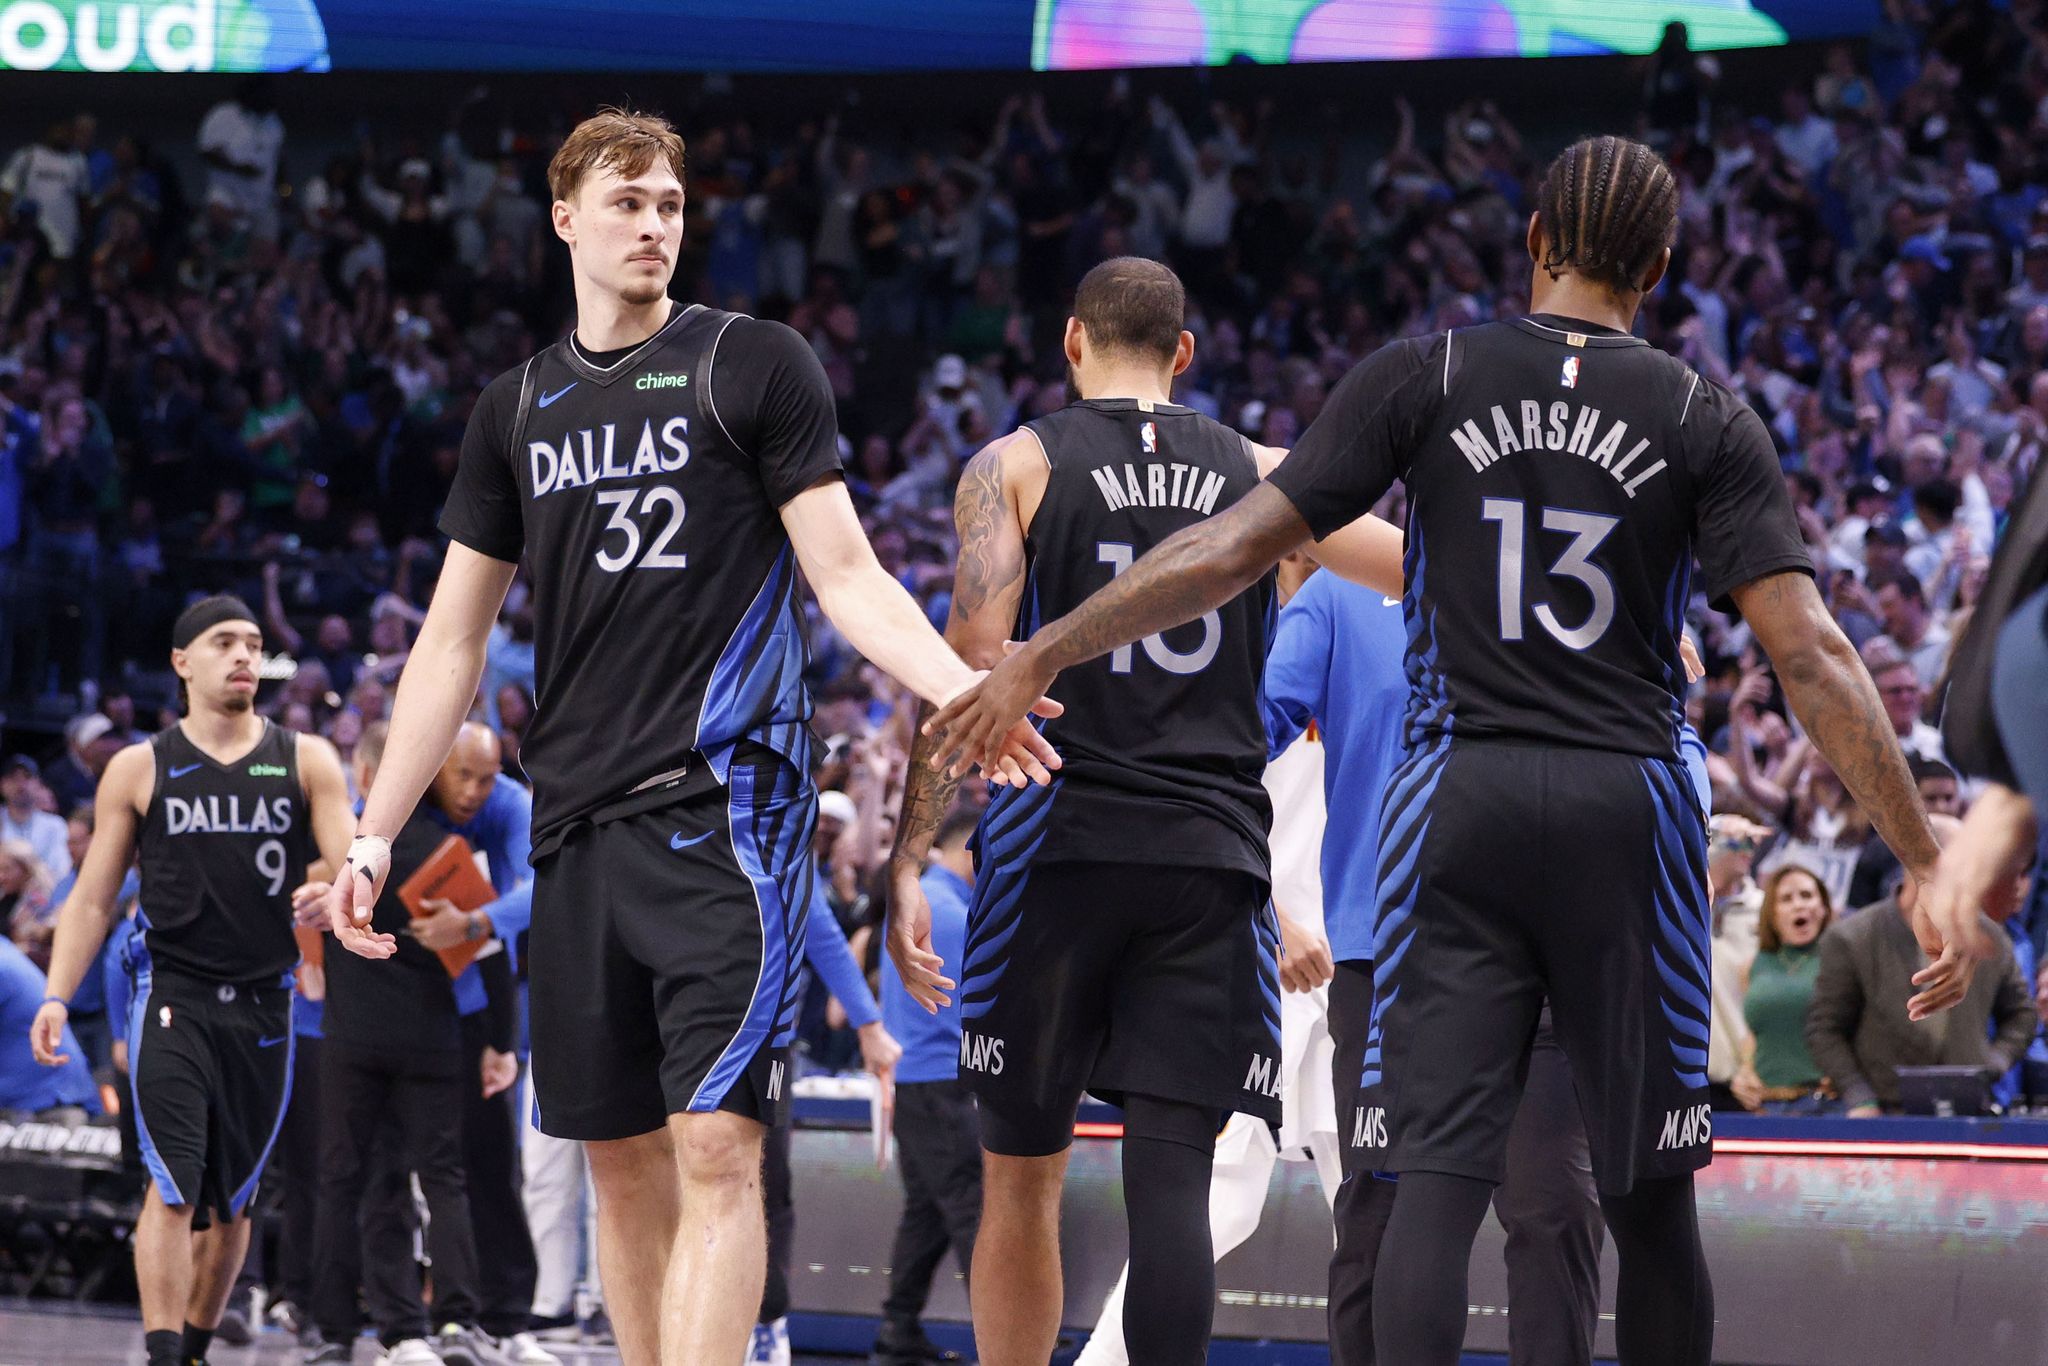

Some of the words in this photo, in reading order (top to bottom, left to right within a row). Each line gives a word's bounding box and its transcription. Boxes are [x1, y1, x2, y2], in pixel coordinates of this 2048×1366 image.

[635, 373, 688, 390] chime
[528, 416, 690, 499] DALLAS
[1450, 399, 1667, 499] MARSHALL
[1090, 463, 1226, 516] MARTIN
[595, 485, 687, 573] 32
[1481, 496, 1623, 652] 13
[164, 793, 292, 835] DALLAS
[255, 839, 287, 896] 9
[960, 1028, 1005, 1076] MAVS
[1351, 1106, 1389, 1148] MAVS
[1656, 1103, 1711, 1150] MAVS
